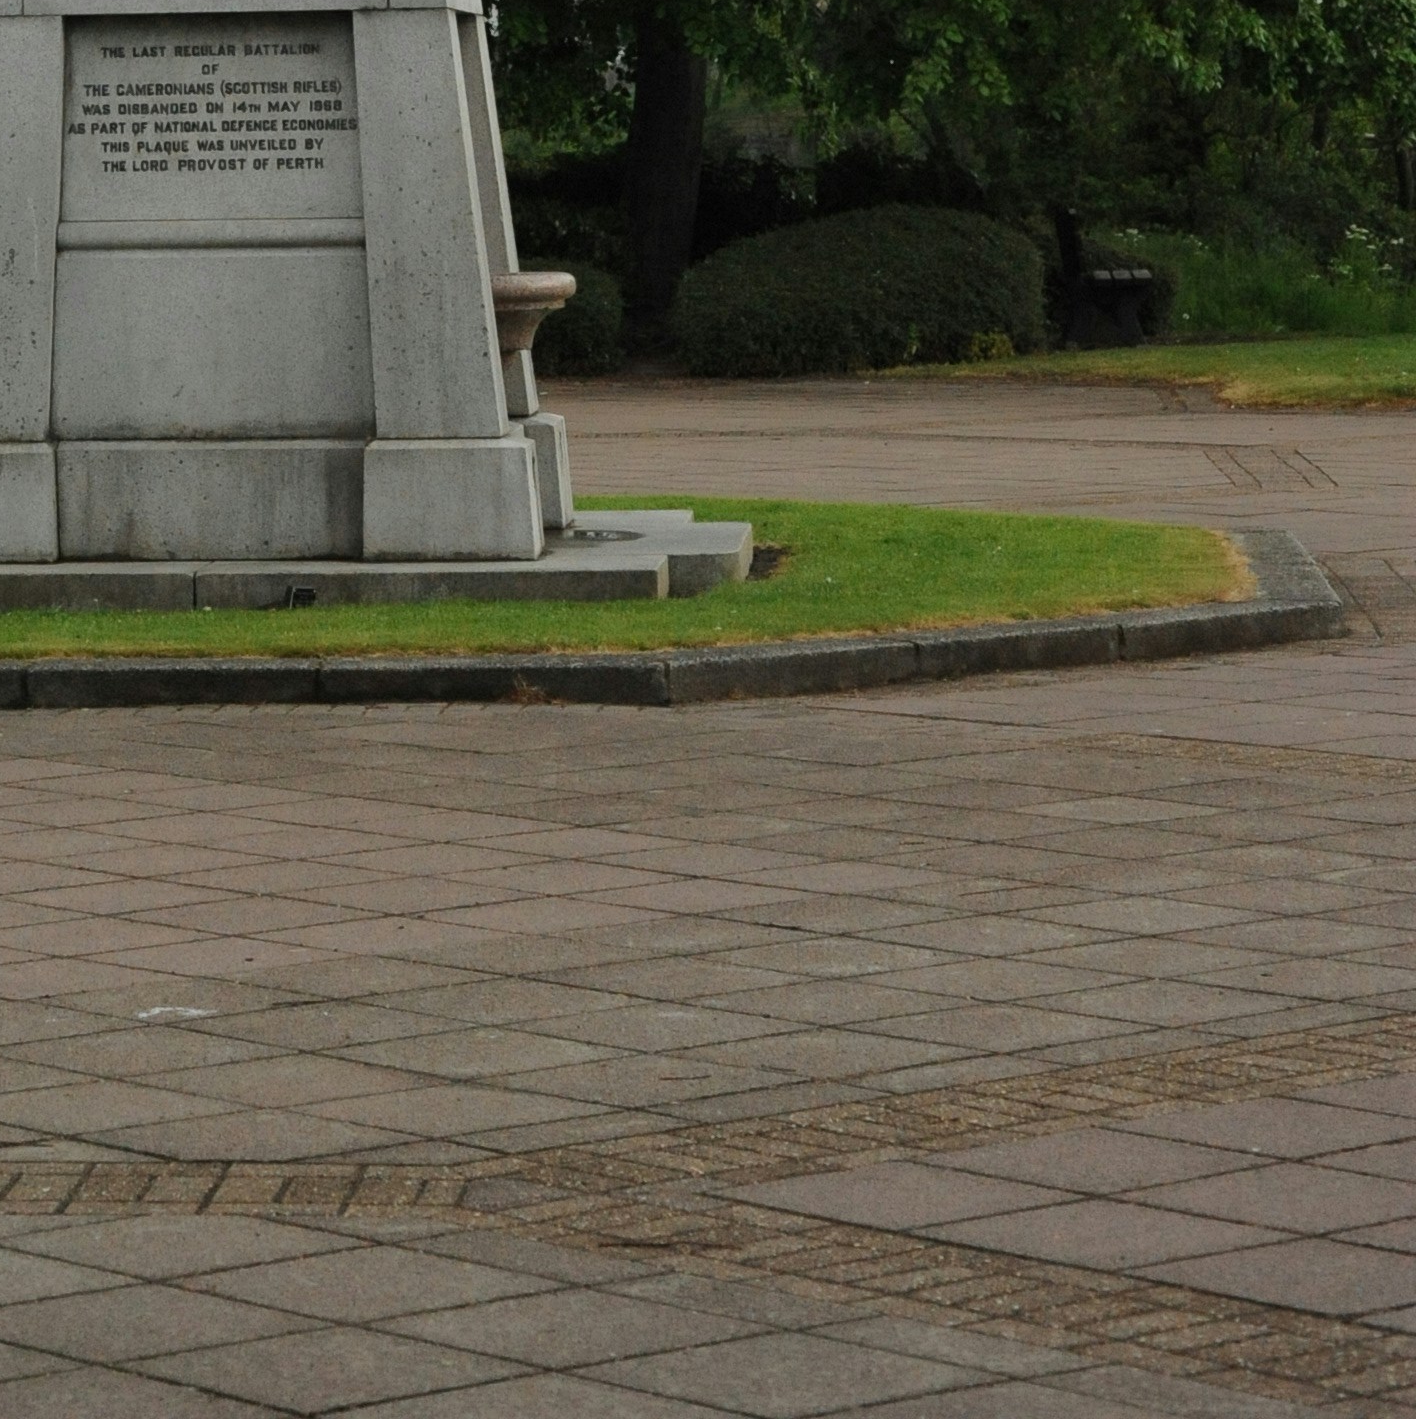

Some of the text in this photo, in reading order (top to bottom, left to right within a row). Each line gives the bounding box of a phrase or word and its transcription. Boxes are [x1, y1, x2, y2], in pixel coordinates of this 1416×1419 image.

[101, 43, 320, 59] THE LAST REGULAR BATTALION
[201, 64, 220, 75] OF
[84, 79, 342, 97] THE CAMERONIANS (SCOTTISH RIFLES)
[82, 104, 111, 116] WAS
[118, 102, 198, 115] DISBANDED
[206, 102, 223, 113] ON
[233, 101, 261, 113] 14TH
[268, 101, 300, 112] MAY
[67, 118, 358, 136] AS PART OF NATIONAL DEFENCE ECONOMIES
[101, 138, 324, 154] THIS PLAQUE WAS UNVEILED BY
[102, 157, 324, 173] THE LORD PROVOST OF PERTH
